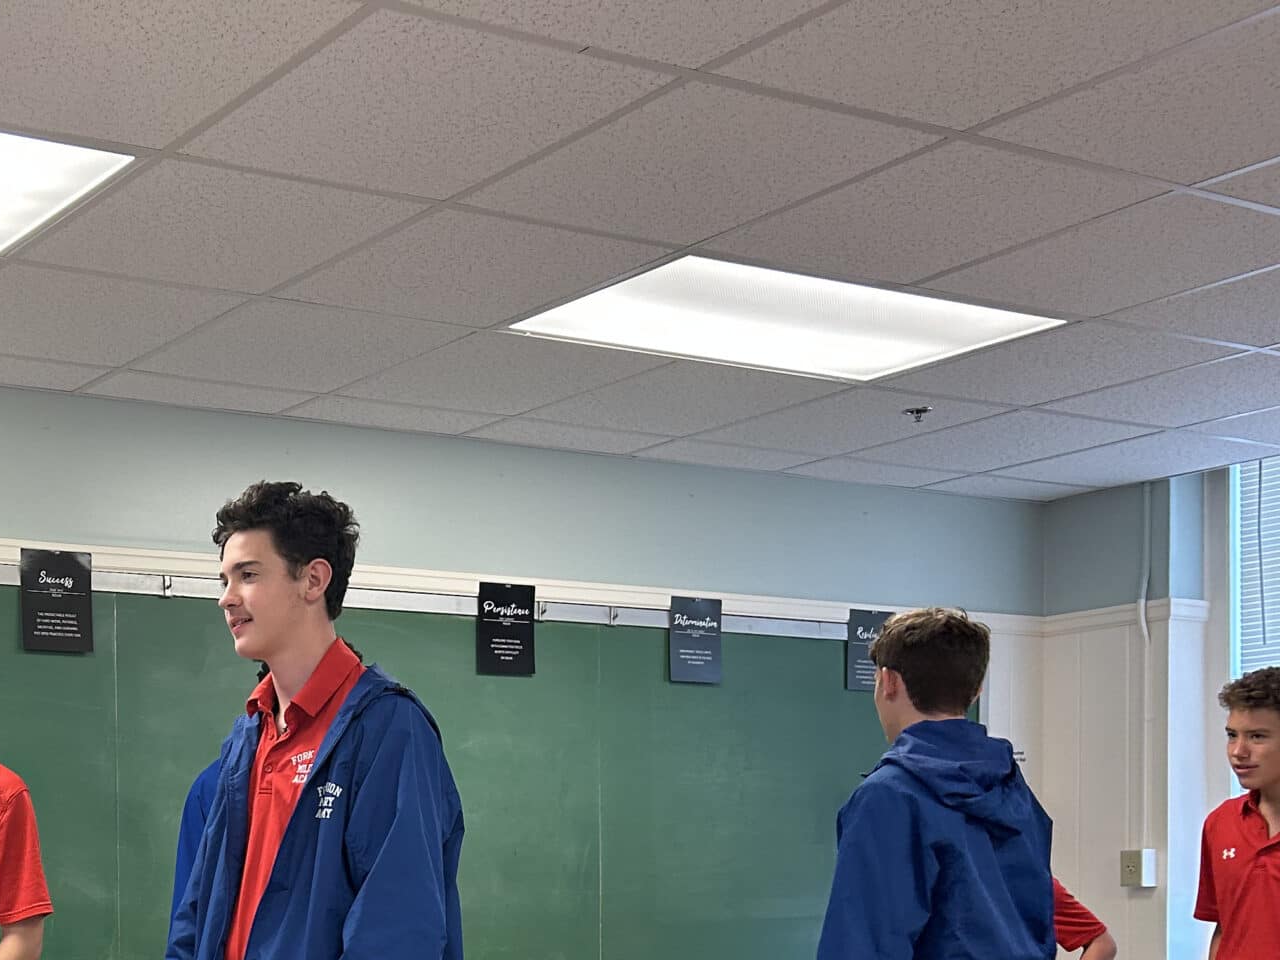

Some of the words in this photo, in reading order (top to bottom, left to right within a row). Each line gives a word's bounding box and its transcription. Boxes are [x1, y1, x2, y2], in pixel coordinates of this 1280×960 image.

[38, 570, 74, 588] Success
[483, 600, 530, 616] Persistence
[674, 613, 718, 628] Determination
[291, 749, 315, 766] FORK
